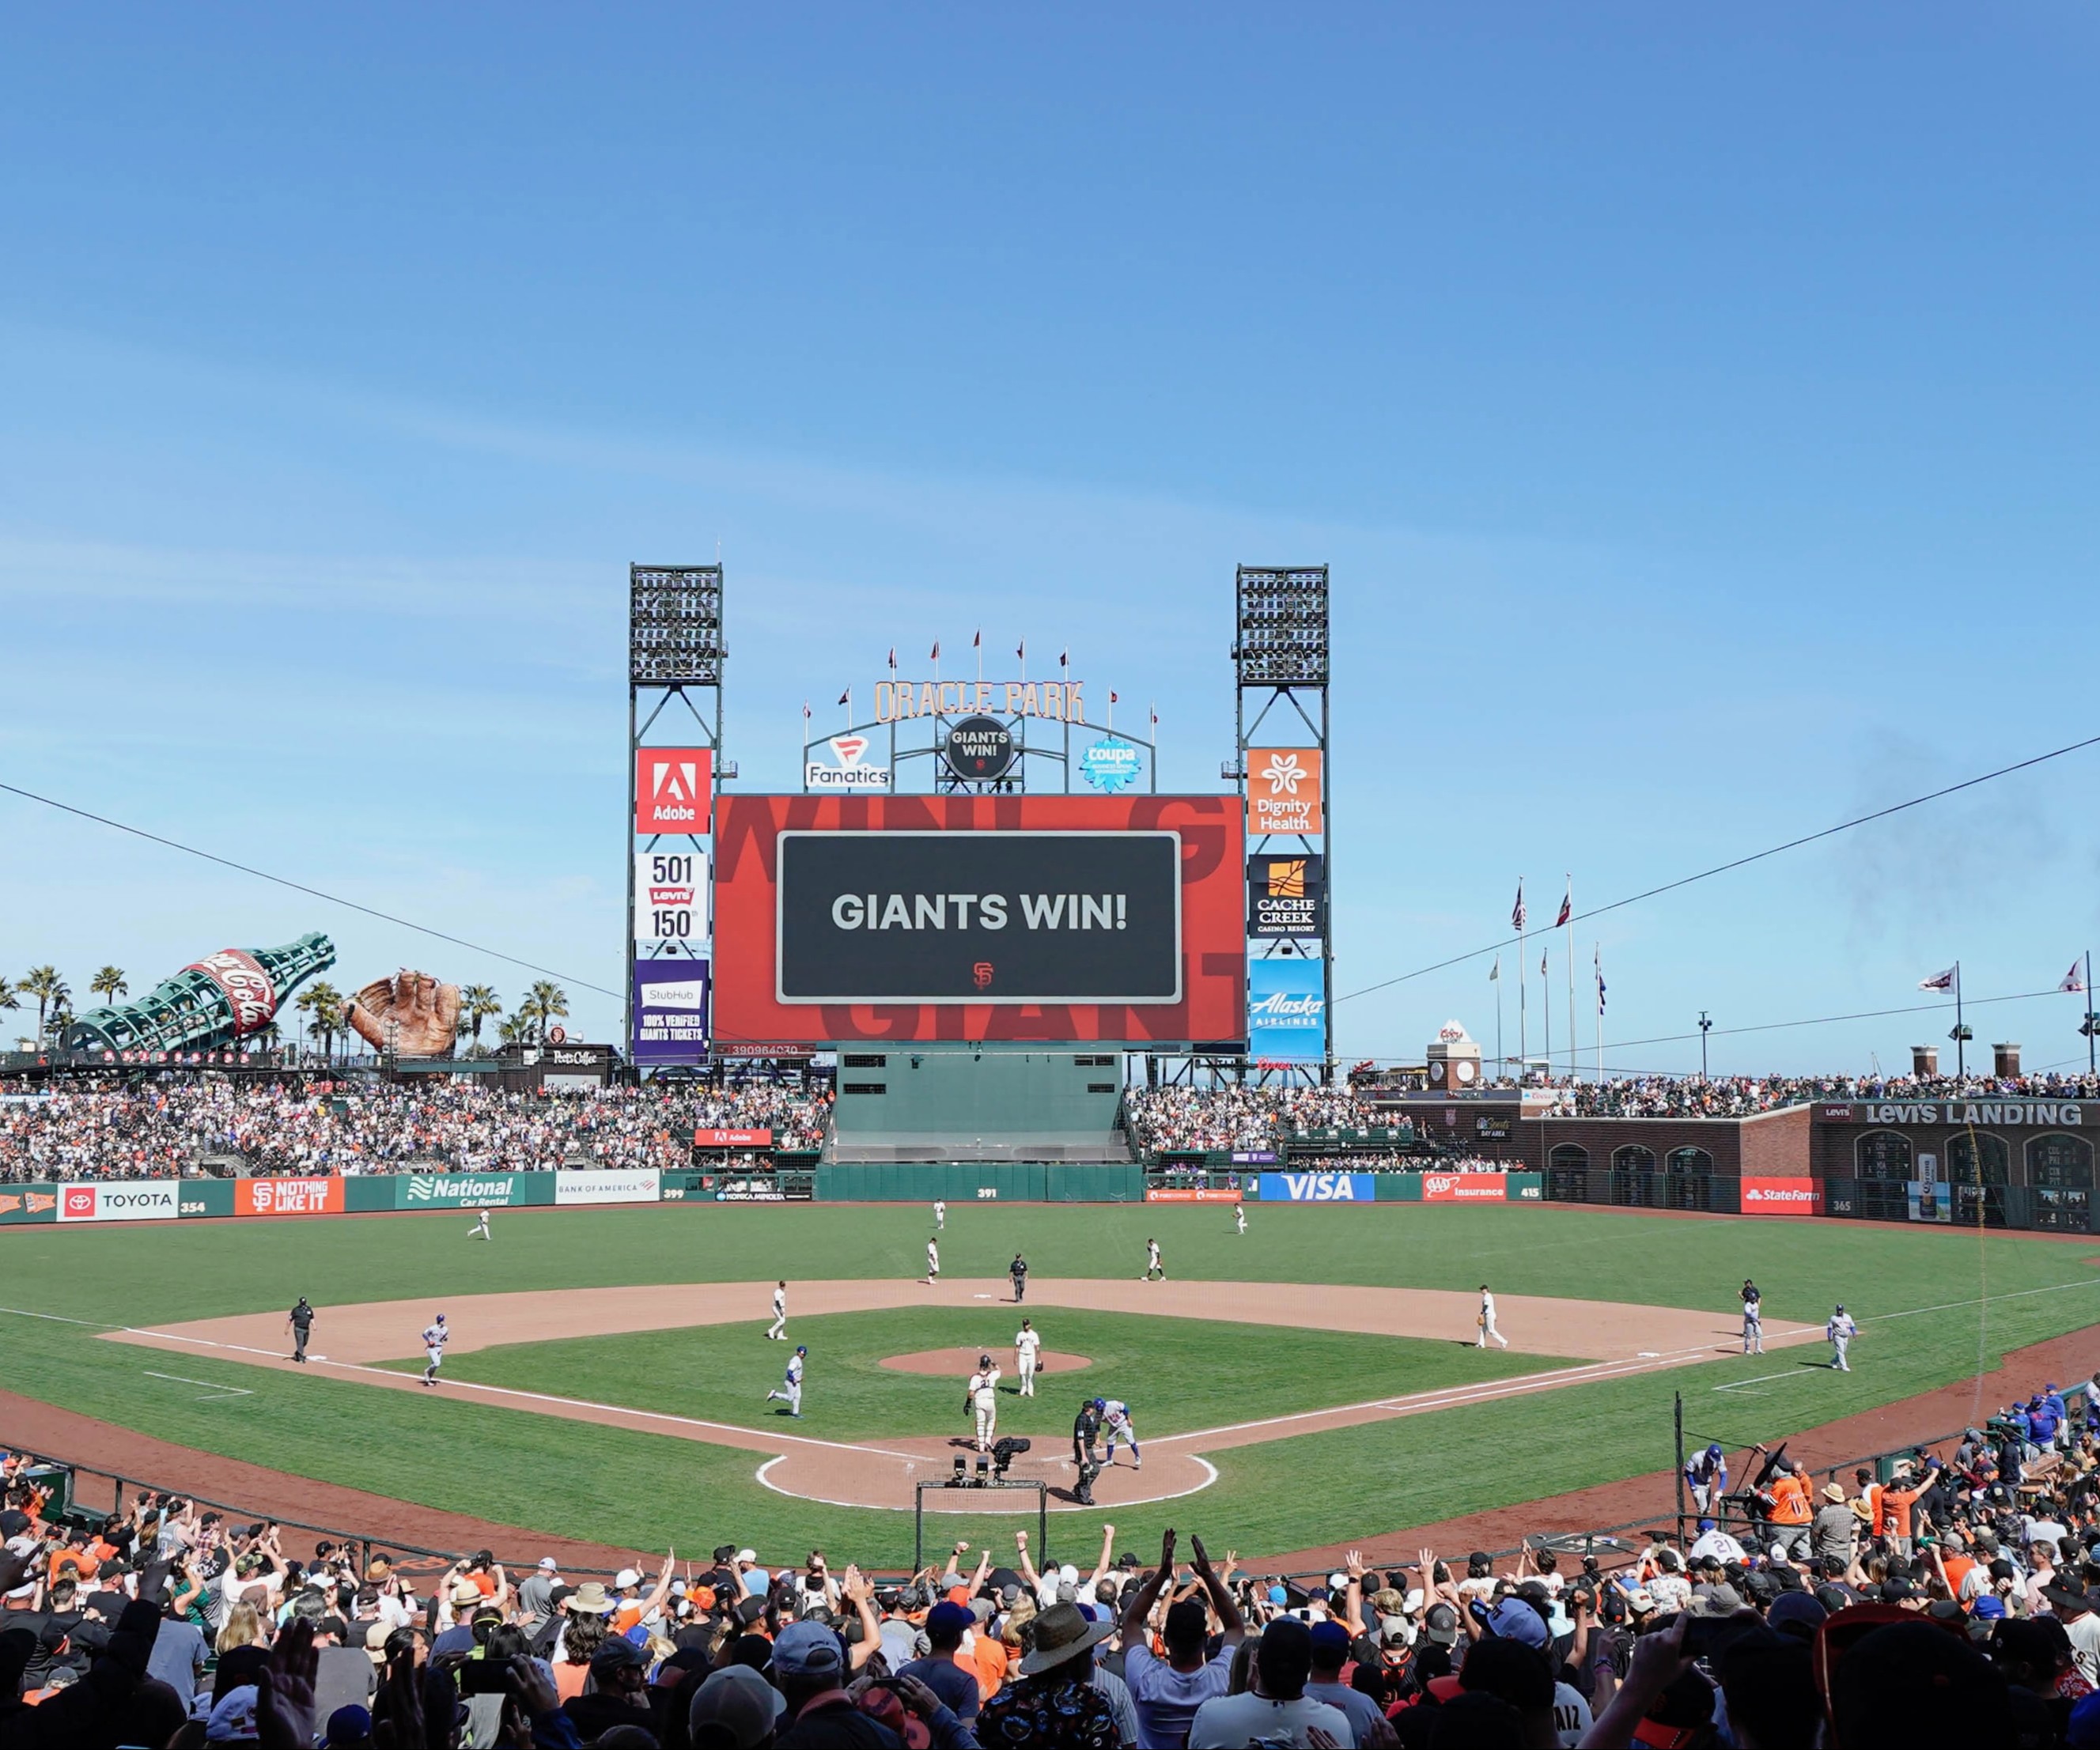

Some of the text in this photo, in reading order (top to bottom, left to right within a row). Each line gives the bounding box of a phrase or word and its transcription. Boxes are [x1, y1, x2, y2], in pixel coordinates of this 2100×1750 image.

[874, 681, 1085, 724] ORACLE PARK
[952, 731, 1008, 743] GIANTS
[962, 744, 997, 757] WIN!
[1088, 748, 1136, 765] coupa
[809, 765, 889, 784] Fanatics
[653, 804, 695, 821] Adobe
[1257, 799, 1311, 816] Dignity
[653, 856, 692, 883] 501
[1258, 899, 1315, 911] CACHE
[832, 894, 1127, 931] GIANTS WIN!
[1259, 912, 1313, 924] CREEK
[649, 988, 694, 1000] StubHub
[1251, 992, 1325, 1016] Alaska
[643, 1015, 700, 1027] 100% VERIFIED
[640, 1028, 703, 1041] GIANTS TICKETS
[574, 1051, 597, 1066] Coffee
[1947, 1104, 2083, 1125] LANDING
[275, 1181, 327, 1196] NOTHING
[664, 1189, 684, 1199] 399
[978, 1189, 997, 1198] 391
[1281, 1175, 1354, 1200] VISA
[1455, 1188, 1504, 1196] Insurance
[1521, 1188, 1539, 1197] 415
[103, 1194, 172, 1208] TOYOTA
[180, 1203, 206, 1213] 354
[275, 1192, 327, 1211] LIKE IT
[460, 1197, 509, 1207] Car Rental
[1714, 1539, 1732, 1554] 21
